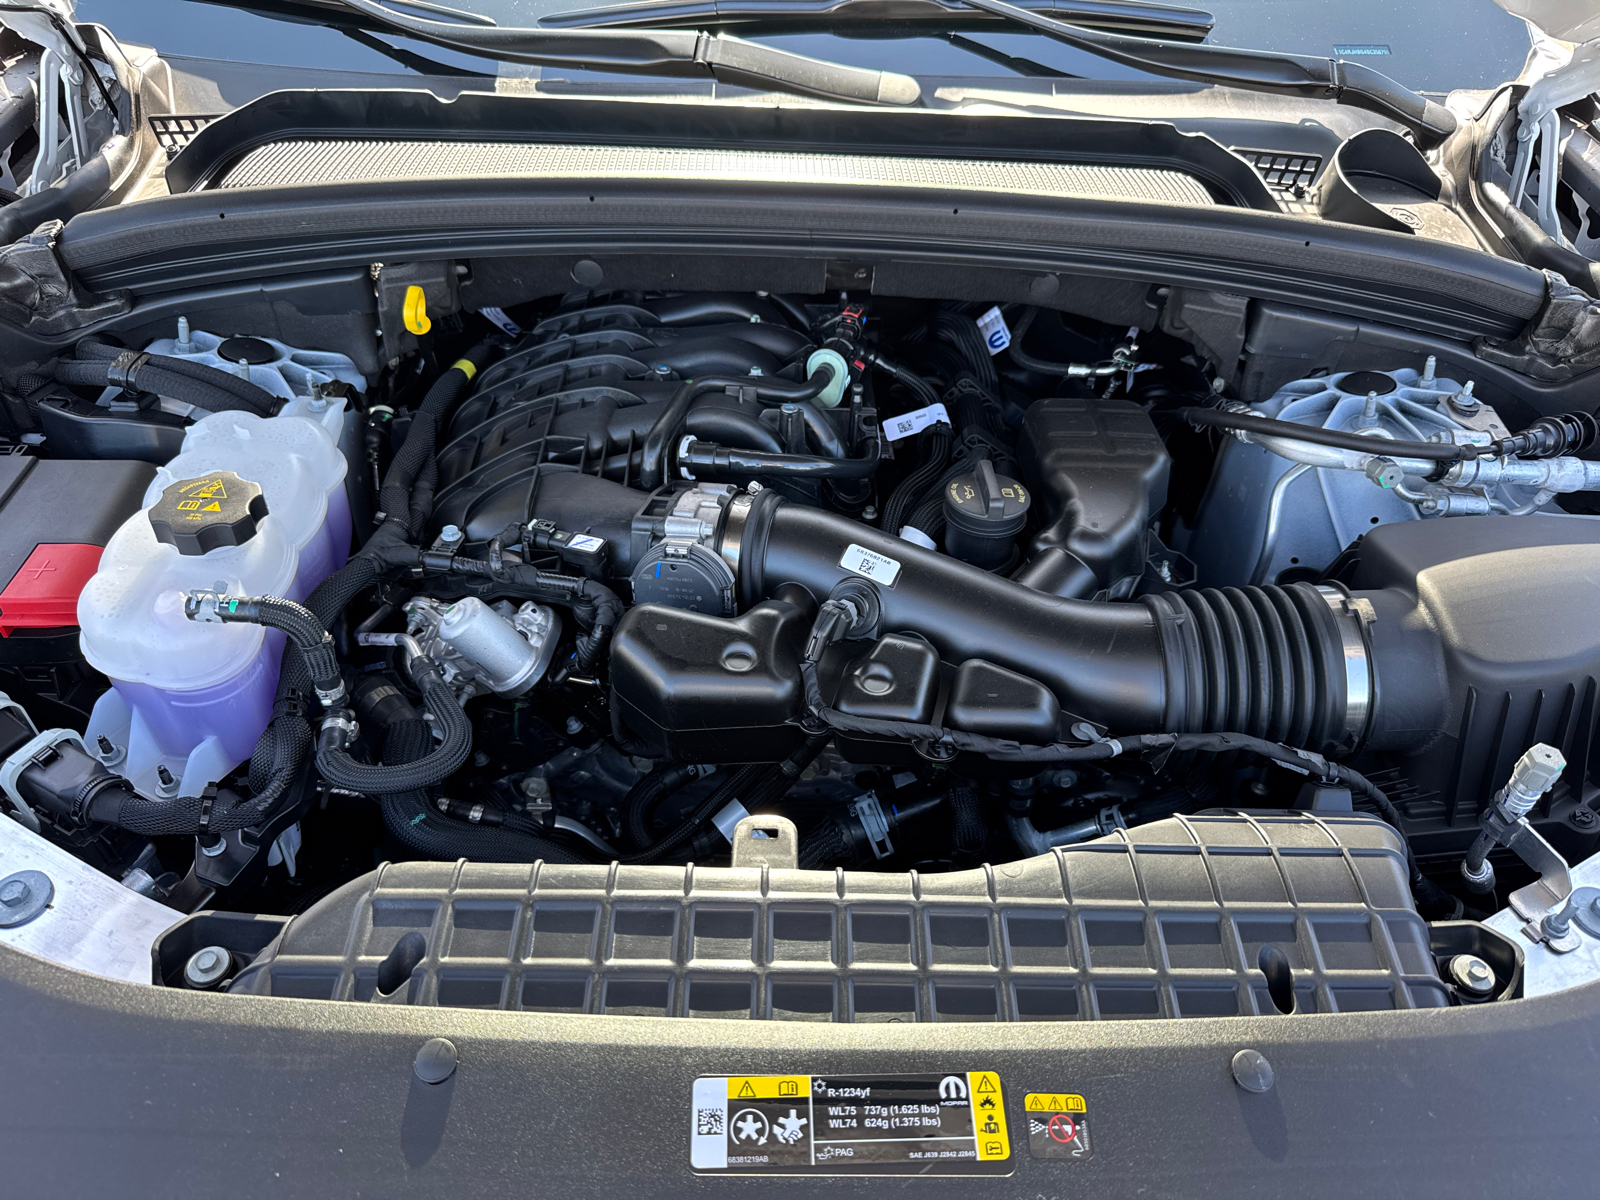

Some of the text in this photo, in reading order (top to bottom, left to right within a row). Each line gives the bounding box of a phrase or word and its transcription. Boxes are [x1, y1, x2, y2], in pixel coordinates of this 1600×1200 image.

[827, 1087, 870, 1098] R-1234yf
[828, 1104, 940, 1116] WL75 737g (1.625 lbs)
[829, 1117, 941, 1129] WL74 624g (1.375 lbs)
[834, 1148, 854, 1157] PAG
[727, 1155, 769, 1163] 68381219AB
